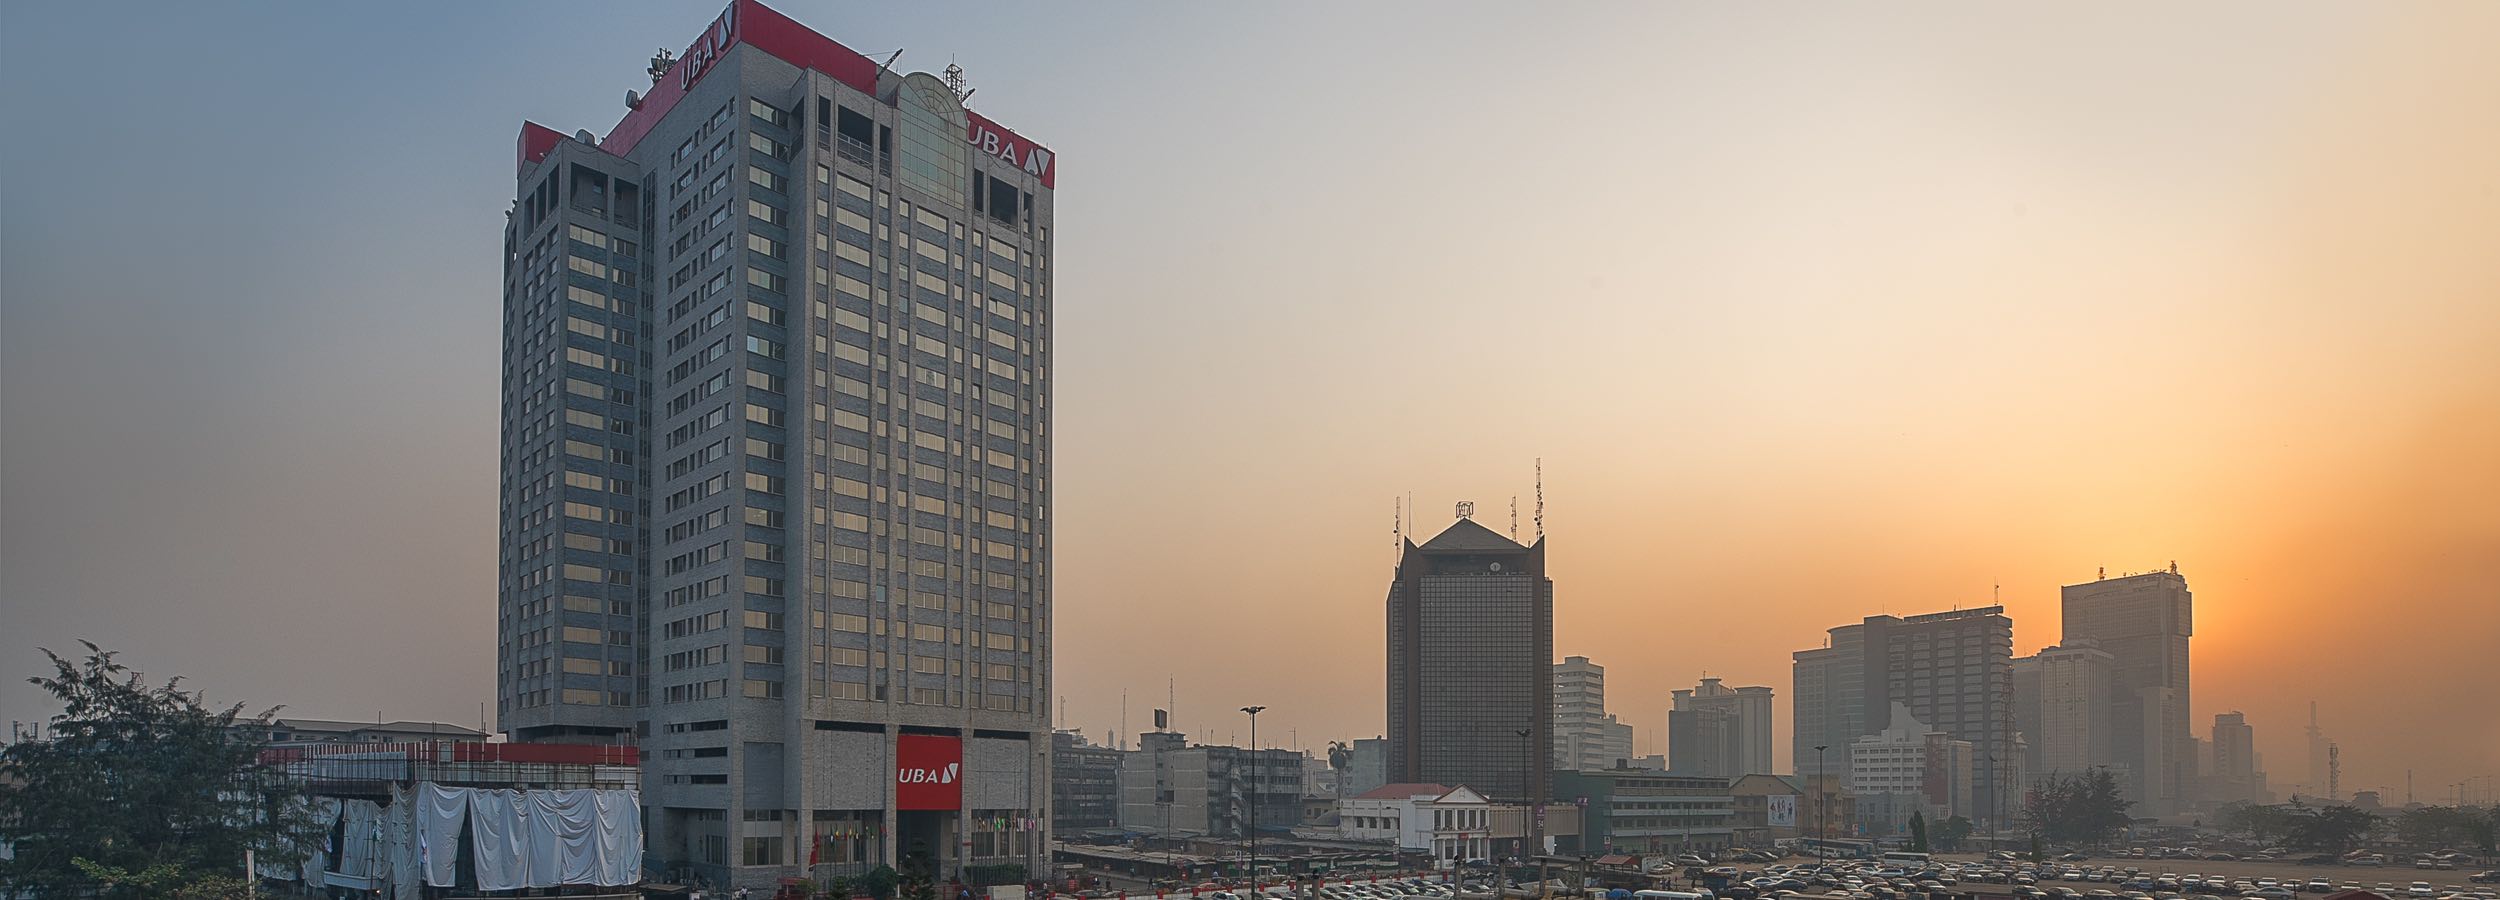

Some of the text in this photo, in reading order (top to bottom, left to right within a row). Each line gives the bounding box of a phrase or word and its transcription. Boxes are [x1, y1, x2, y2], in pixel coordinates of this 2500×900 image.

[681, 37, 713, 90] UBA
[967, 120, 1018, 166] UBA
[899, 768, 938, 783] UBA
